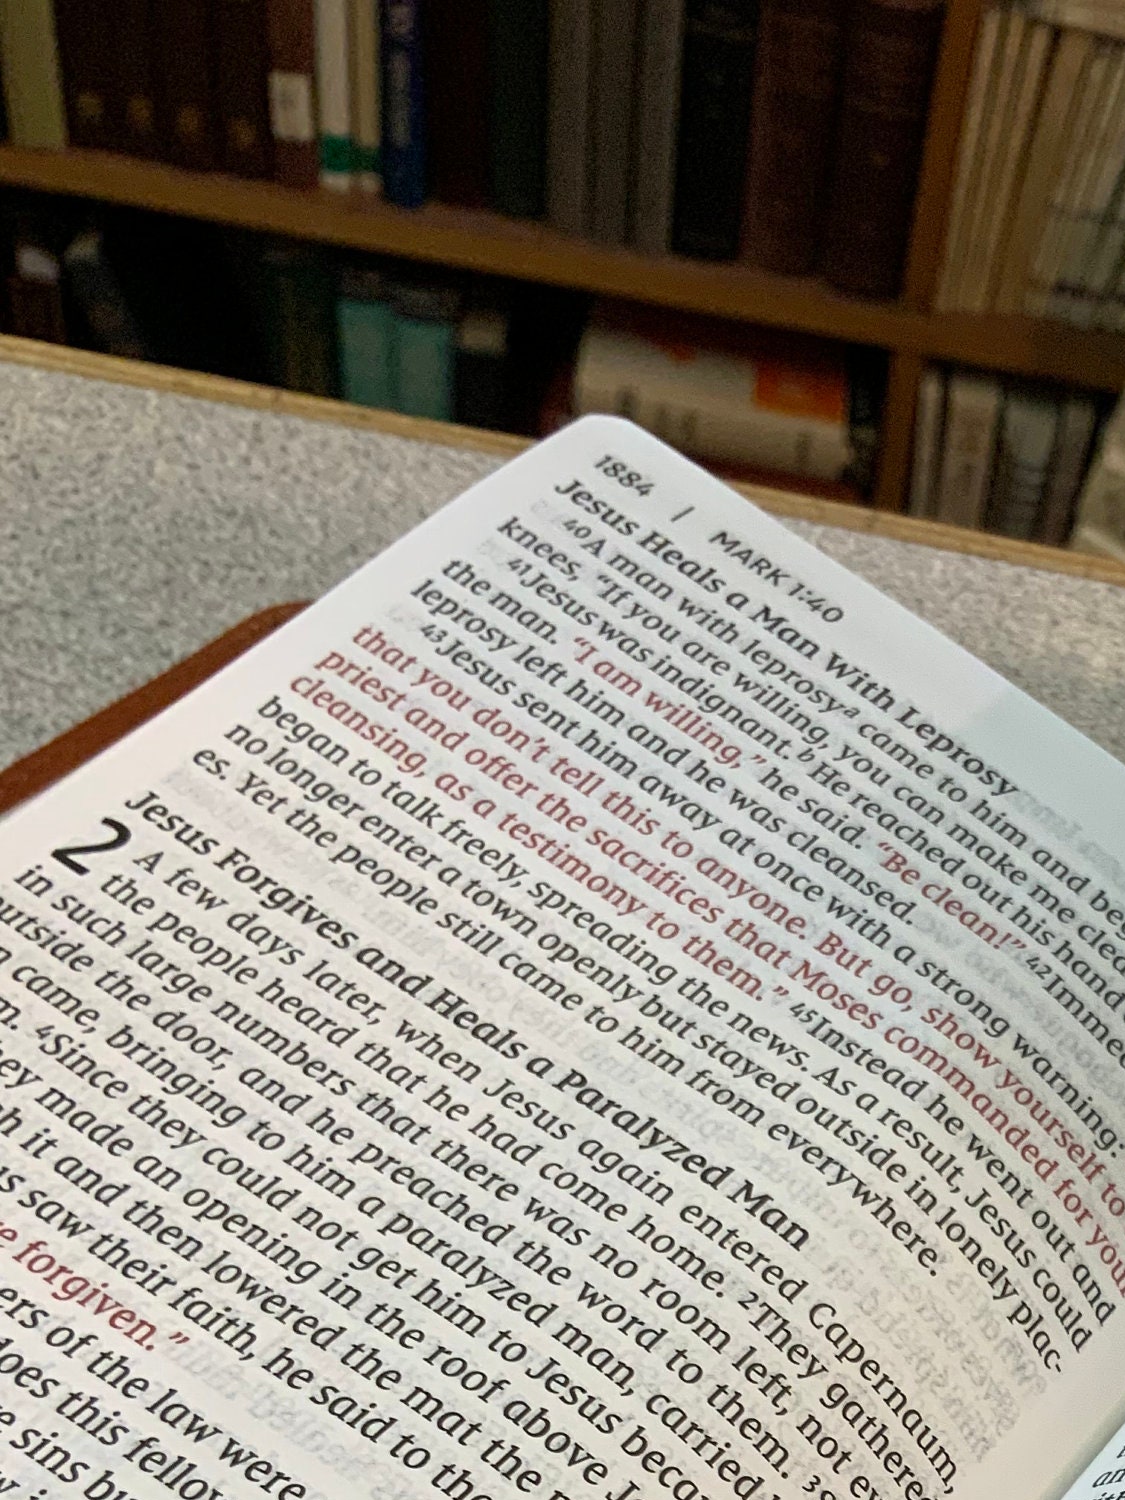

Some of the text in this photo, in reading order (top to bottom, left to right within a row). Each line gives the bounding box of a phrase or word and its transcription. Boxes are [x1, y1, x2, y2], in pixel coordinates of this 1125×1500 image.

[554, 479, 1020, 797] Jesus Heals a Man With Leprosy
[594, 454, 845, 624] 1884 MARK 1:40
[51, 817, 132, 876] 2
[351, 626, 418, 674] that
[409, 666, 473, 712] you
[471, 707, 551, 764] don’t
[549, 757, 606, 798] tell
[601, 790, 662, 836] this
[660, 830, 694, 859] to
[695, 856, 807, 941] anyone.
[813, 930, 873, 979] But
[866, 974, 914, 1013] go,
[920, 1007, 1003, 1069] show
[994, 1068, 1107, 1184] yourself
[441, 559, 492, 596] the
[487, 591, 558, 645] man.
[573, 636, 599, 665] “I
[592, 660, 643, 698] am
[644, 690, 767, 770] willing,”
[758, 766, 800, 802] he
[796, 797, 867, 850] said.
[876, 841, 921, 886] “Be
[920, 883, 1028, 950] clean!”
[124, 791, 810, 1252] Jesus Forgives and Heals a Paralyzed Man
[132, 851, 957, 1495] A few days later, when Jesus again entered Capernaum,
[11, 1239, 191, 1352] forgiven.”
